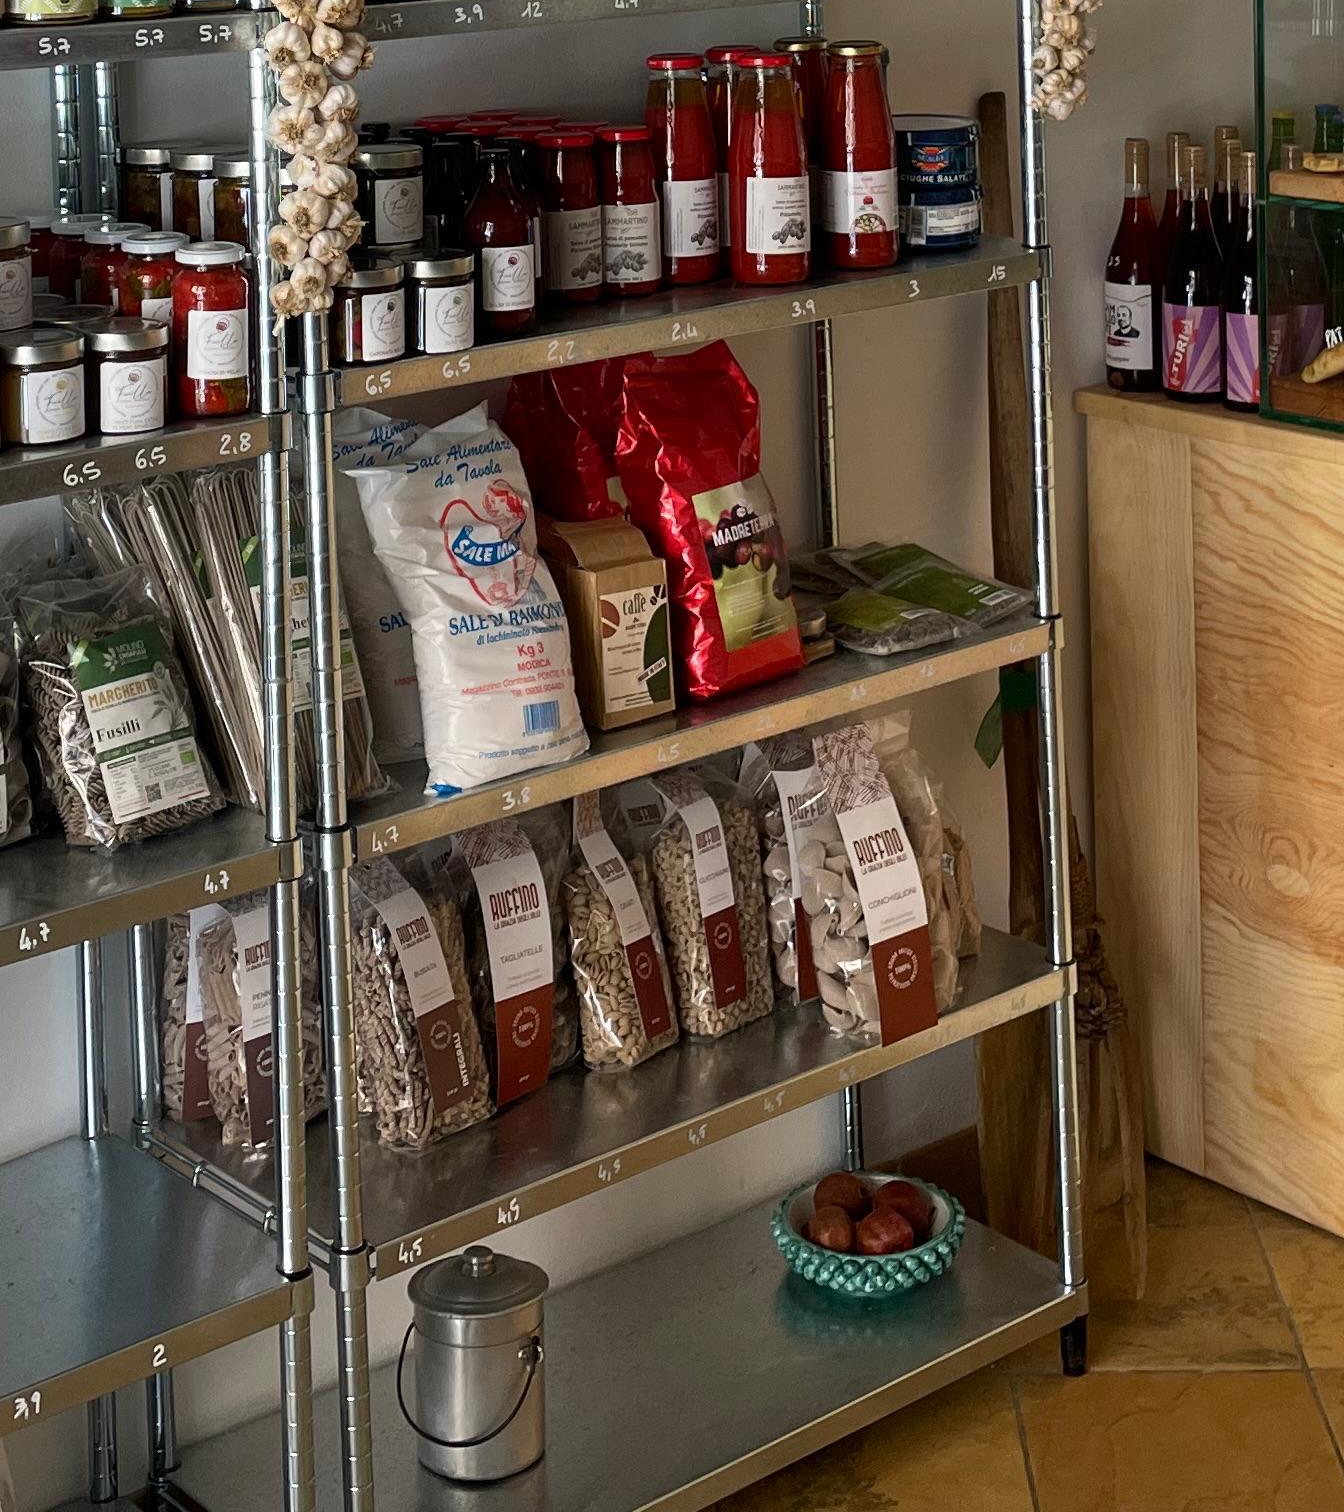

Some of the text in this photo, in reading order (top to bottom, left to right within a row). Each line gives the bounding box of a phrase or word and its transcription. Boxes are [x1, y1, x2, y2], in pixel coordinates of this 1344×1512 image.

[455, 4, 484, 25] 3,9
[521, 1, 542, 18] 12
[199, 24, 232, 42] 5,7
[987, 265, 1005, 281] 15
[908, 280, 919, 296] 3
[366, 370, 392, 395] 6,5
[220, 432, 252, 455] 2,8
[446, 439, 512, 464] Alimentare
[435, 459, 502, 488] da Tavola
[454, 539, 493, 562] SALE
[623, 592, 646, 616] caffè
[449, 614, 489, 636] SALE
[517, 642, 545, 657] Kg 3
[517, 659, 551, 672] MODICA
[88, 678, 159, 708] MARGHERITO
[96, 718, 141, 743] Fusilli
[853, 827, 904, 866] RUFFINO
[489, 883, 540, 922] RUFFINO
[868, 887, 917, 910] CONCHIGLIONI
[395, 915, 429, 945] RUFFINO
[500, 944, 544, 963] TAGLIATELLE
[452, 1032, 470, 1088] INTEGRALI
[153, 1344, 168, 1367] 2
